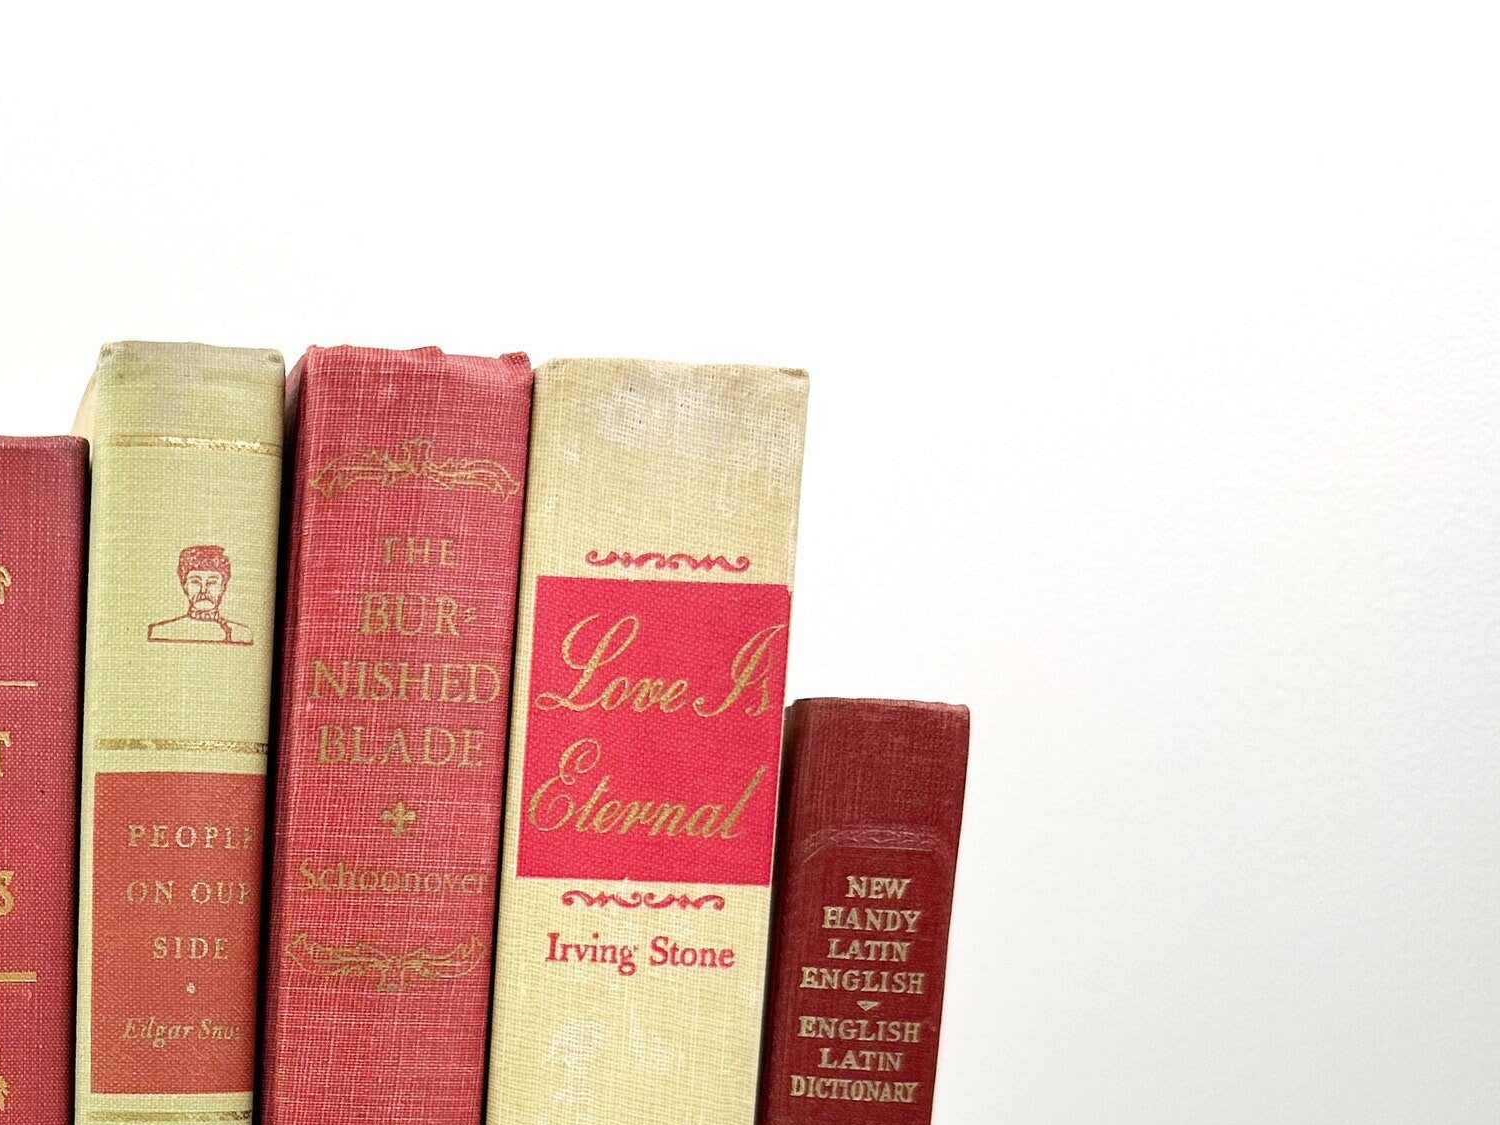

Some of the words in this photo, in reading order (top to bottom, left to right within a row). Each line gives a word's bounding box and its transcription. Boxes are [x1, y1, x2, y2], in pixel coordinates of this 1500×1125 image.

[381, 536, 456, 567] THE
[534, 613, 688, 713] Love
[693, 624, 786, 718] Is
[310, 659, 501, 703] NISHED
[318, 725, 485, 768] BLADE
[528, 737, 767, 840] Eternal
[300, 859, 489, 893] Schoonover
[845, 875, 912, 900] NEW
[126, 881, 174, 905] ON
[821, 906, 921, 933] HANDY
[153, 937, 229, 960] SIDE
[545, 932, 636, 976] Irving
[649, 935, 735, 968] Stone
[828, 938, 911, 963] LATIN
[800, 967, 925, 995] ENGLISH
[122, 1017, 194, 1048] Edgar
[798, 1015, 921, 1043] ENGLISH
[818, 1047, 903, 1072] LATIN
[790, 1074, 919, 1103] DICTIONARY
